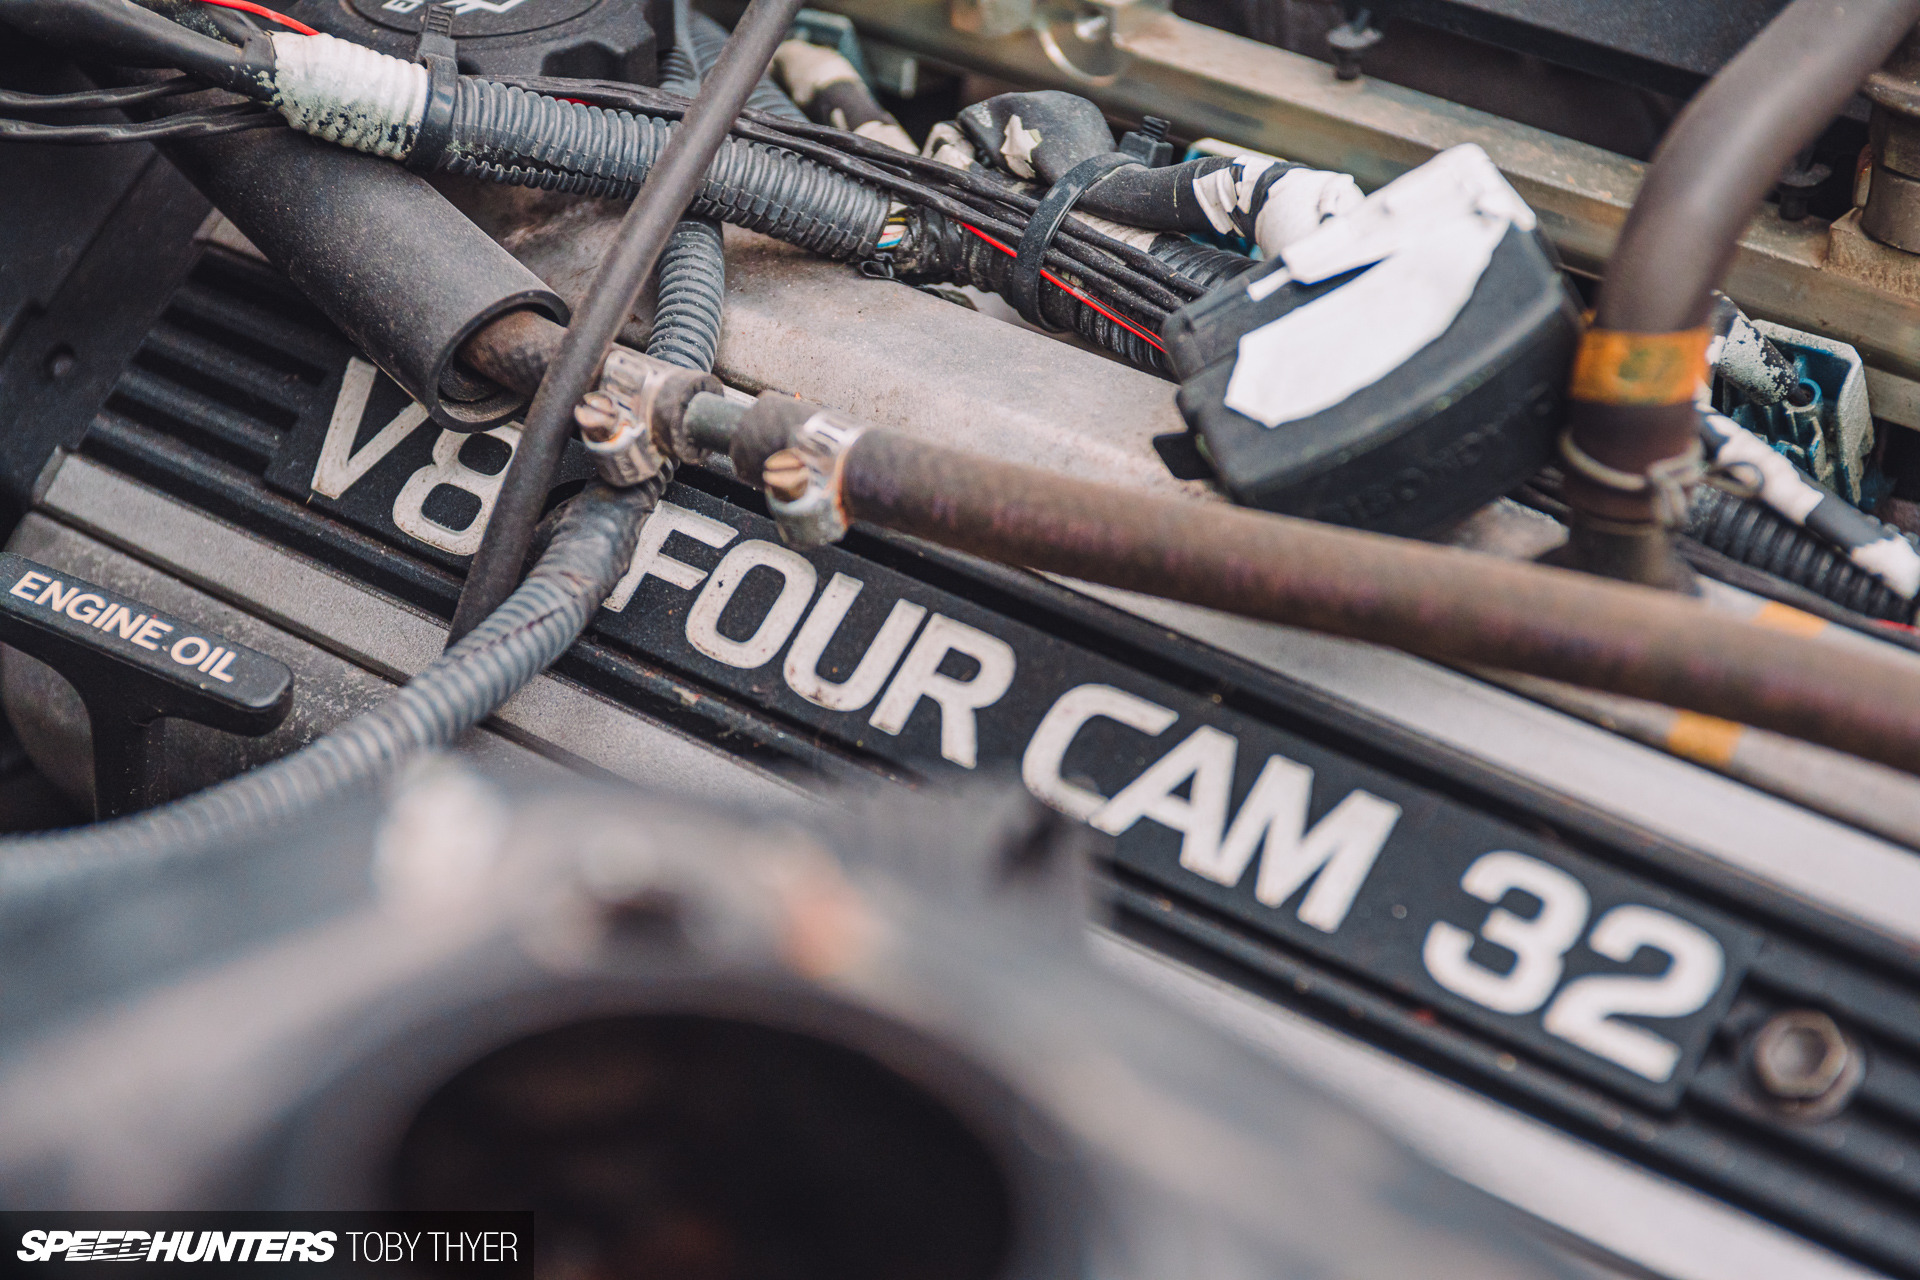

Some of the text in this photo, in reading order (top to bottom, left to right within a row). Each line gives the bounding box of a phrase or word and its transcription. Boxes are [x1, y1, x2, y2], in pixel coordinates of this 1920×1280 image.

[9, 570, 236, 683] ENGINE OIL
[311, 356, 1725, 1083] V8 FOUR CAM 32
